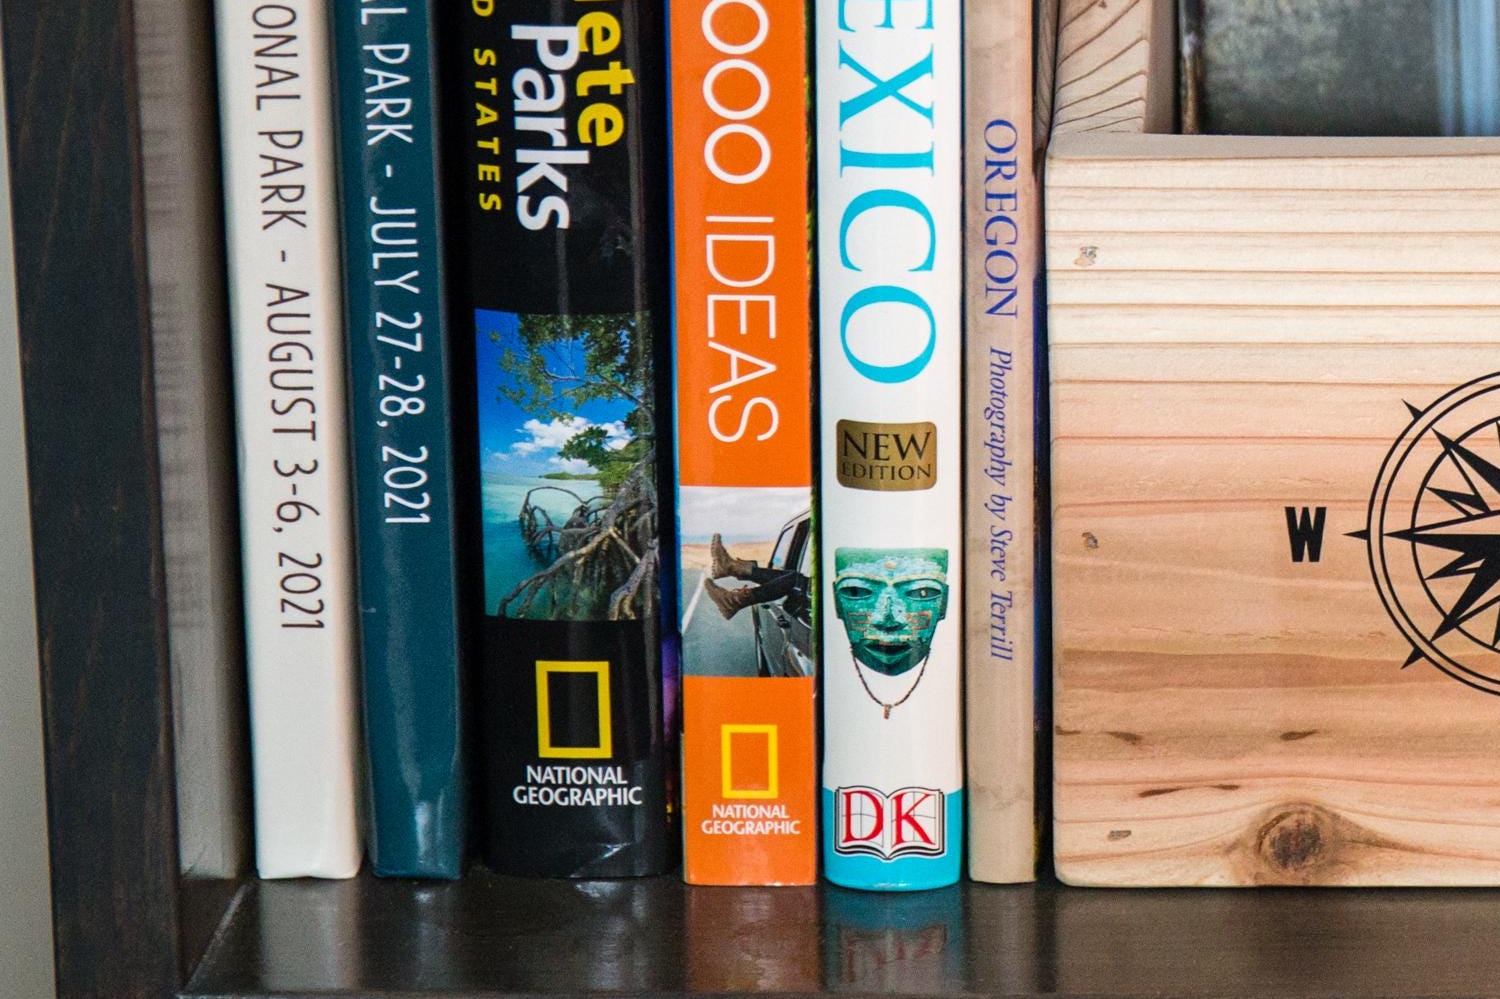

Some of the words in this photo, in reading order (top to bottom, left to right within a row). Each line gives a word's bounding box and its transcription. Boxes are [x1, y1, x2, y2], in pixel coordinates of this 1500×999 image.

[362, 43, 413, 146] PARK
[473, 47, 503, 212] STATES
[510, 24, 590, 232] Parks
[257, 129, 307, 231] PARK
[984, 119, 1018, 316] OREGON
[369, 195, 420, 294] JULY
[265, 283, 317, 442] AUGUST
[705, 215, 779, 443] IDEAS
[375, 311, 426, 428] 27-28,
[842, 429, 933, 462] NEW
[983, 347, 1013, 487] Photography
[273, 459, 320, 533] 3-6,
[381, 445, 431, 524] 2021
[841, 461, 933, 482] EDITION
[983, 493, 1013, 521] by
[989, 524, 1013, 582] Steve
[1284, 506, 1327, 563] W
[278, 552, 325, 629] 2021
[989, 590, 1014, 661] Terrill
[513, 785, 643, 807] GEOGRAPHIC
[526, 765, 628, 785] NATIONAL
[712, 804, 789, 820] NATIONAL
[701, 819, 800, 836] GEOGRAPHIC
[841, 789, 937, 849] DK
